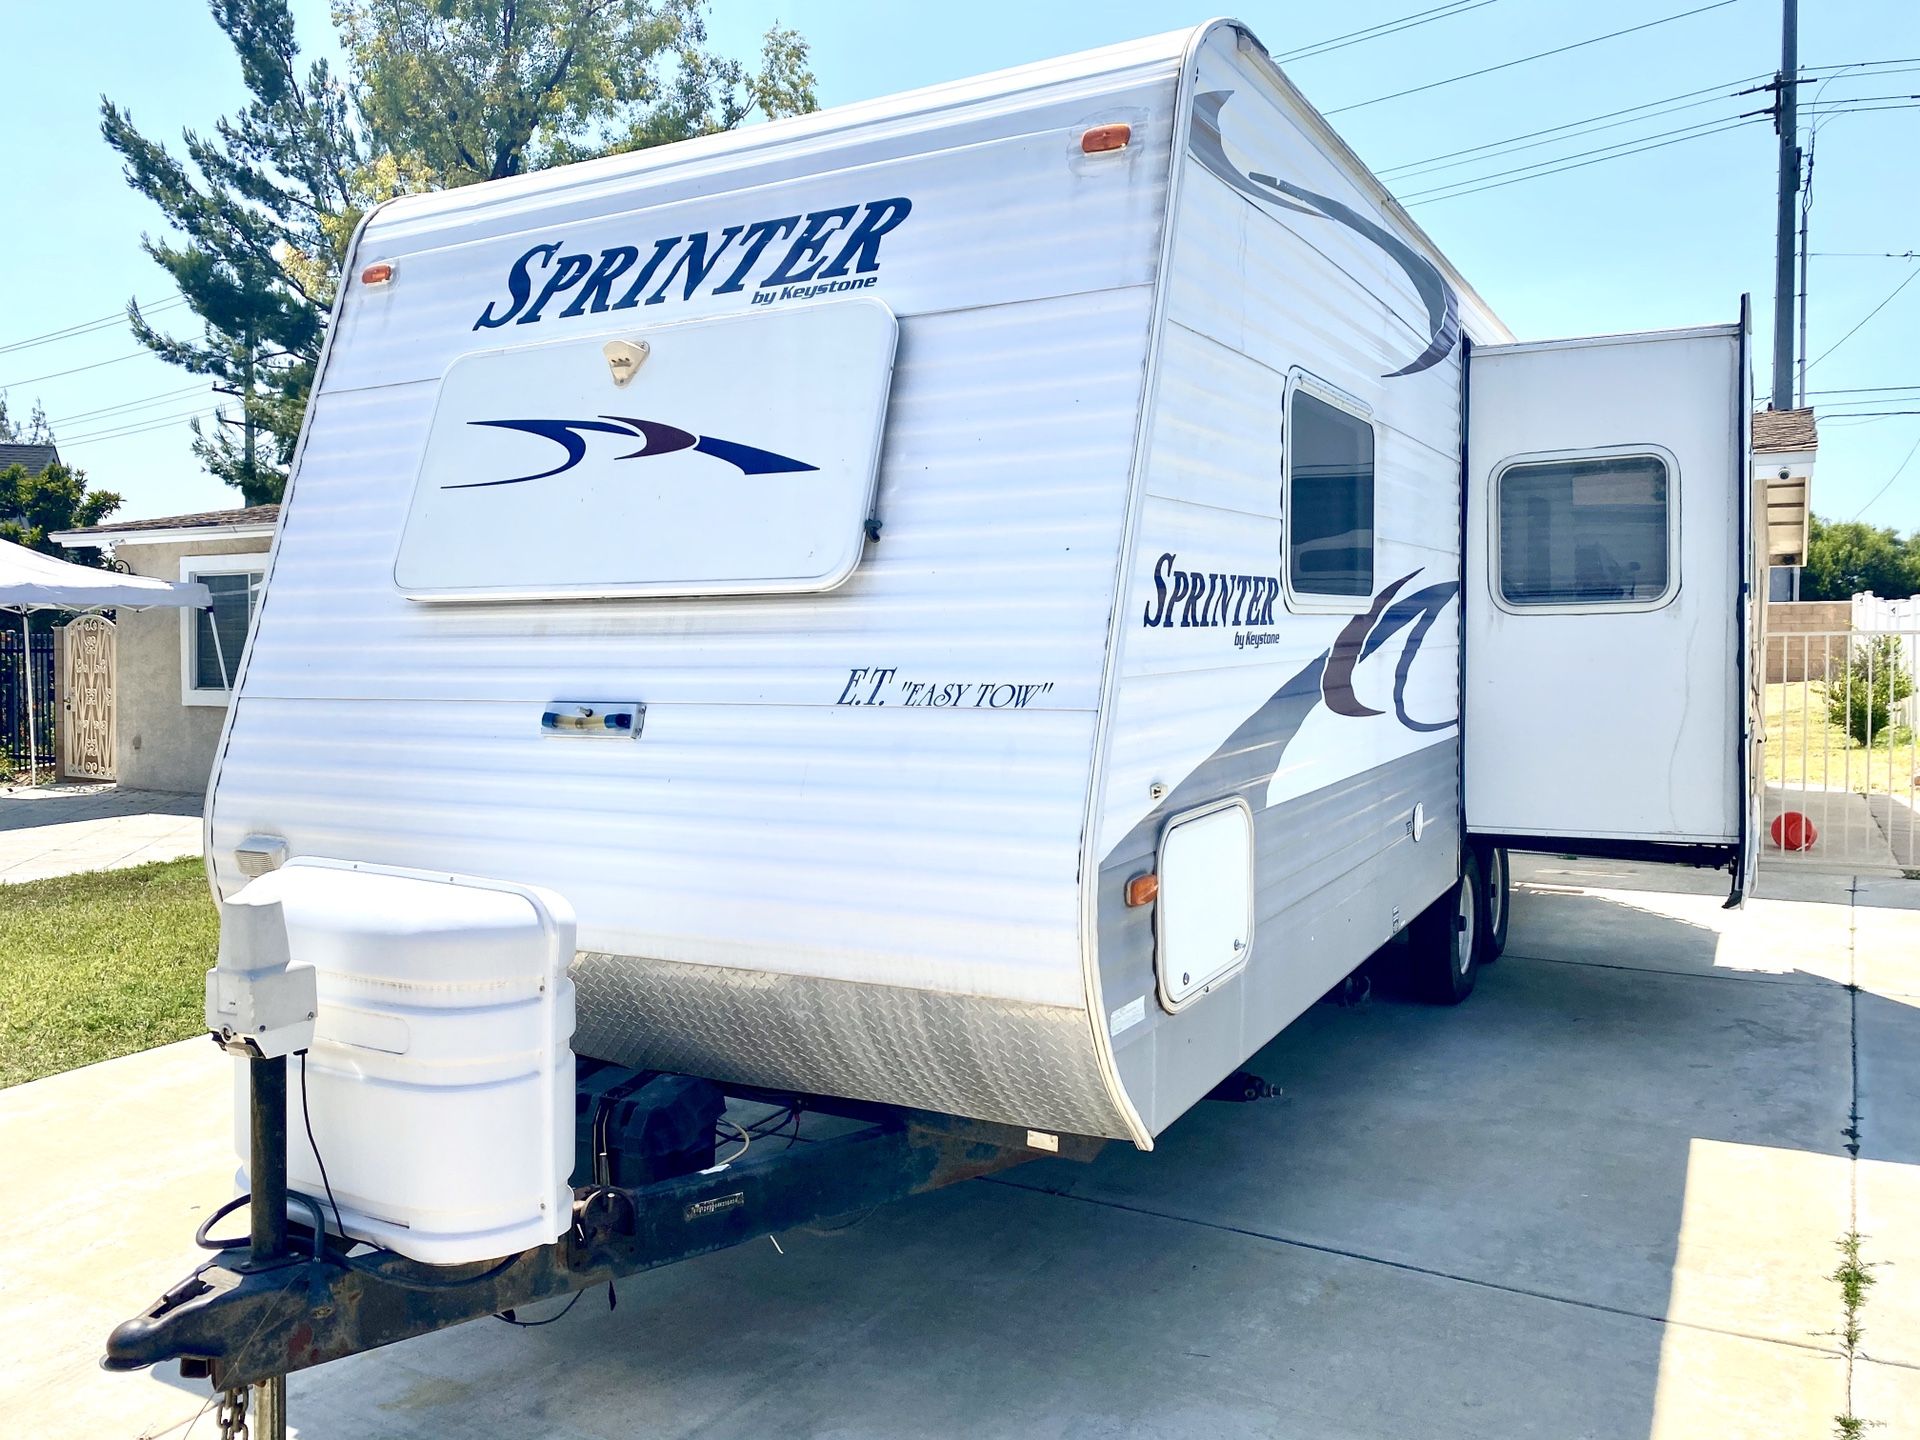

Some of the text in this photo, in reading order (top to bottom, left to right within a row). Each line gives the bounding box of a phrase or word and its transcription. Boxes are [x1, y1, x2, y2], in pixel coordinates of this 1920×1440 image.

[473, 197, 912, 331] SPRINTER
[751, 275, 878, 306] by Keystone
[1143, 552, 1279, 628] SPRINTER
[1234, 631, 1280, 650] by Keystone
[836, 667, 1054, 709] E.T. "EASY TOW"
